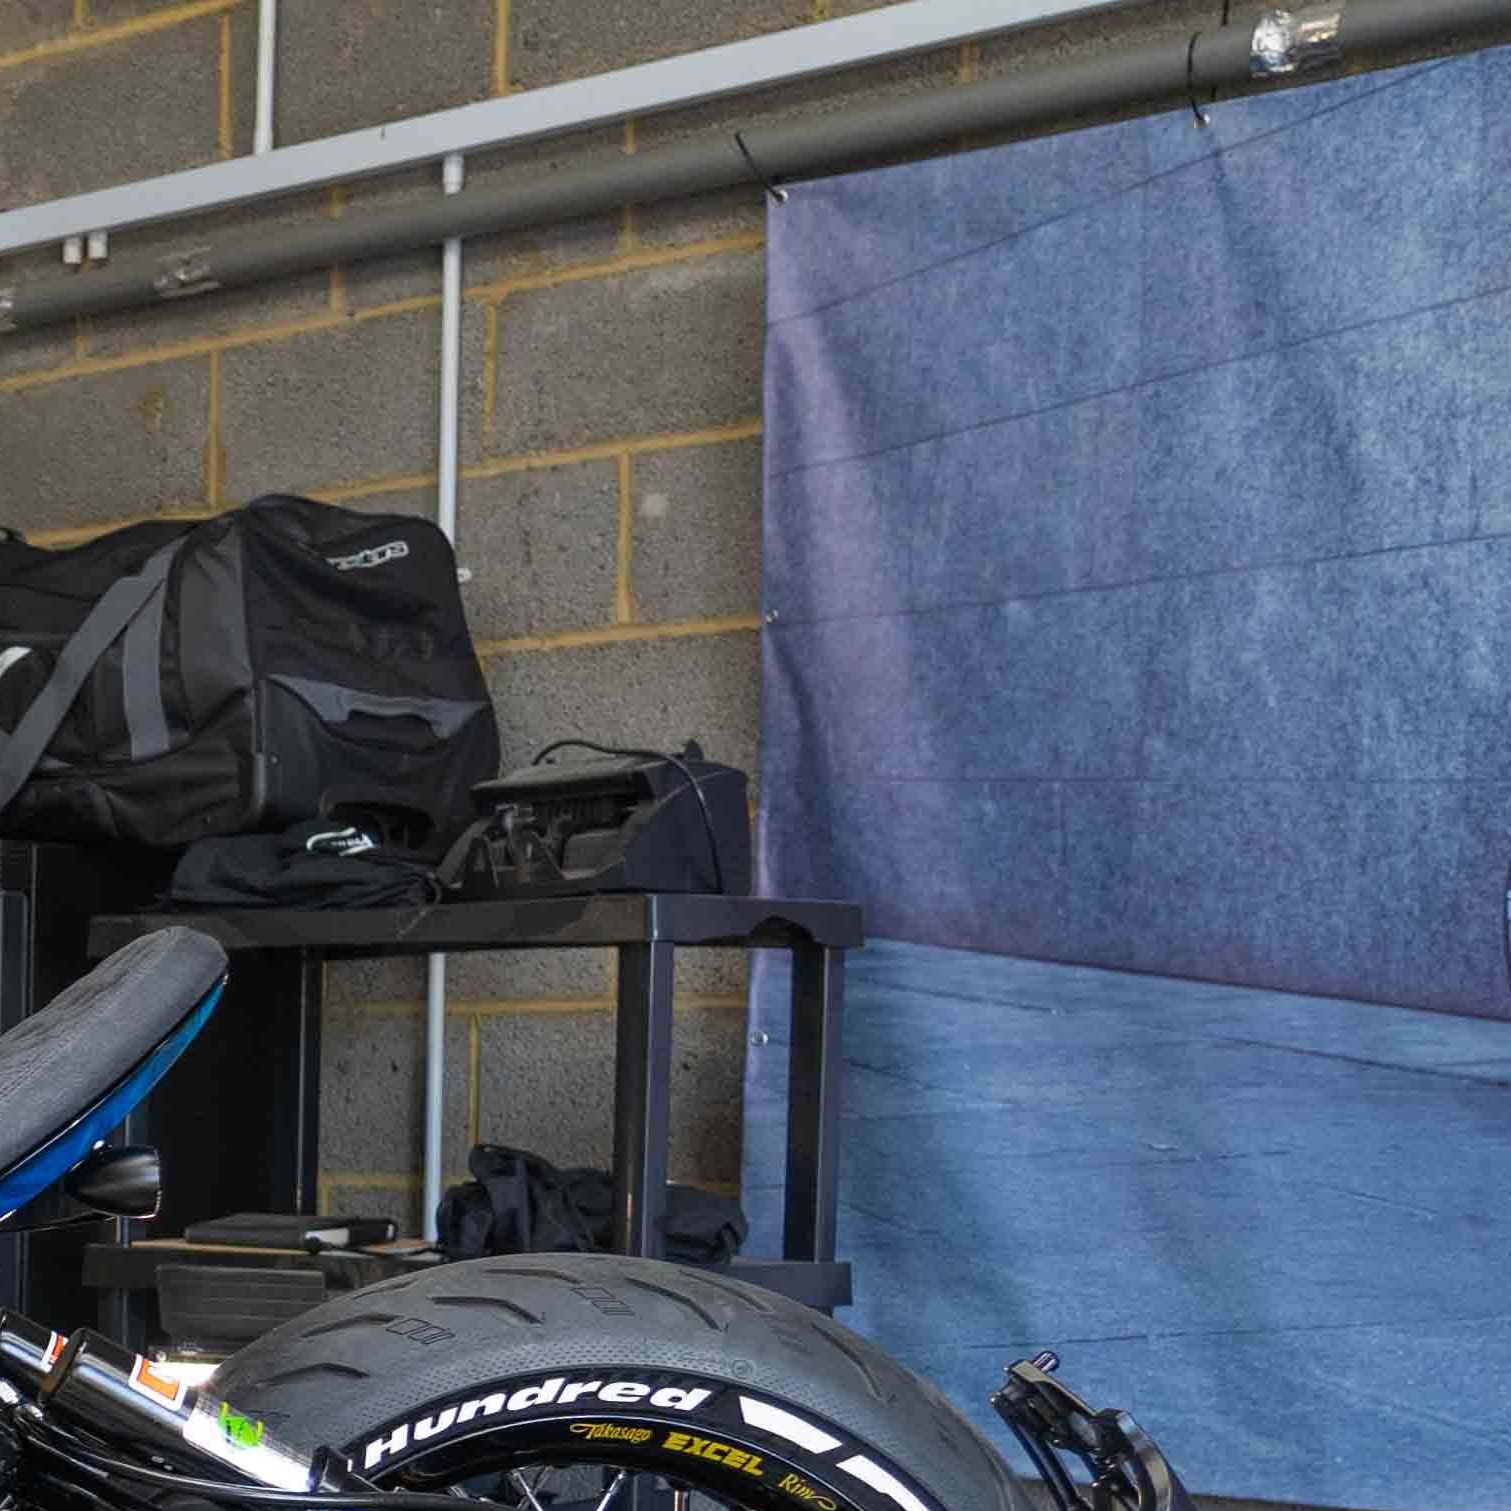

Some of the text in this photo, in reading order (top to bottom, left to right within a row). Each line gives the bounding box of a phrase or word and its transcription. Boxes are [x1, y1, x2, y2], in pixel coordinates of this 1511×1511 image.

[364, 1377, 713, 1470] Hundred
[569, 1422, 654, 1443] Takasago
[662, 1431, 766, 1476] EXCEL
